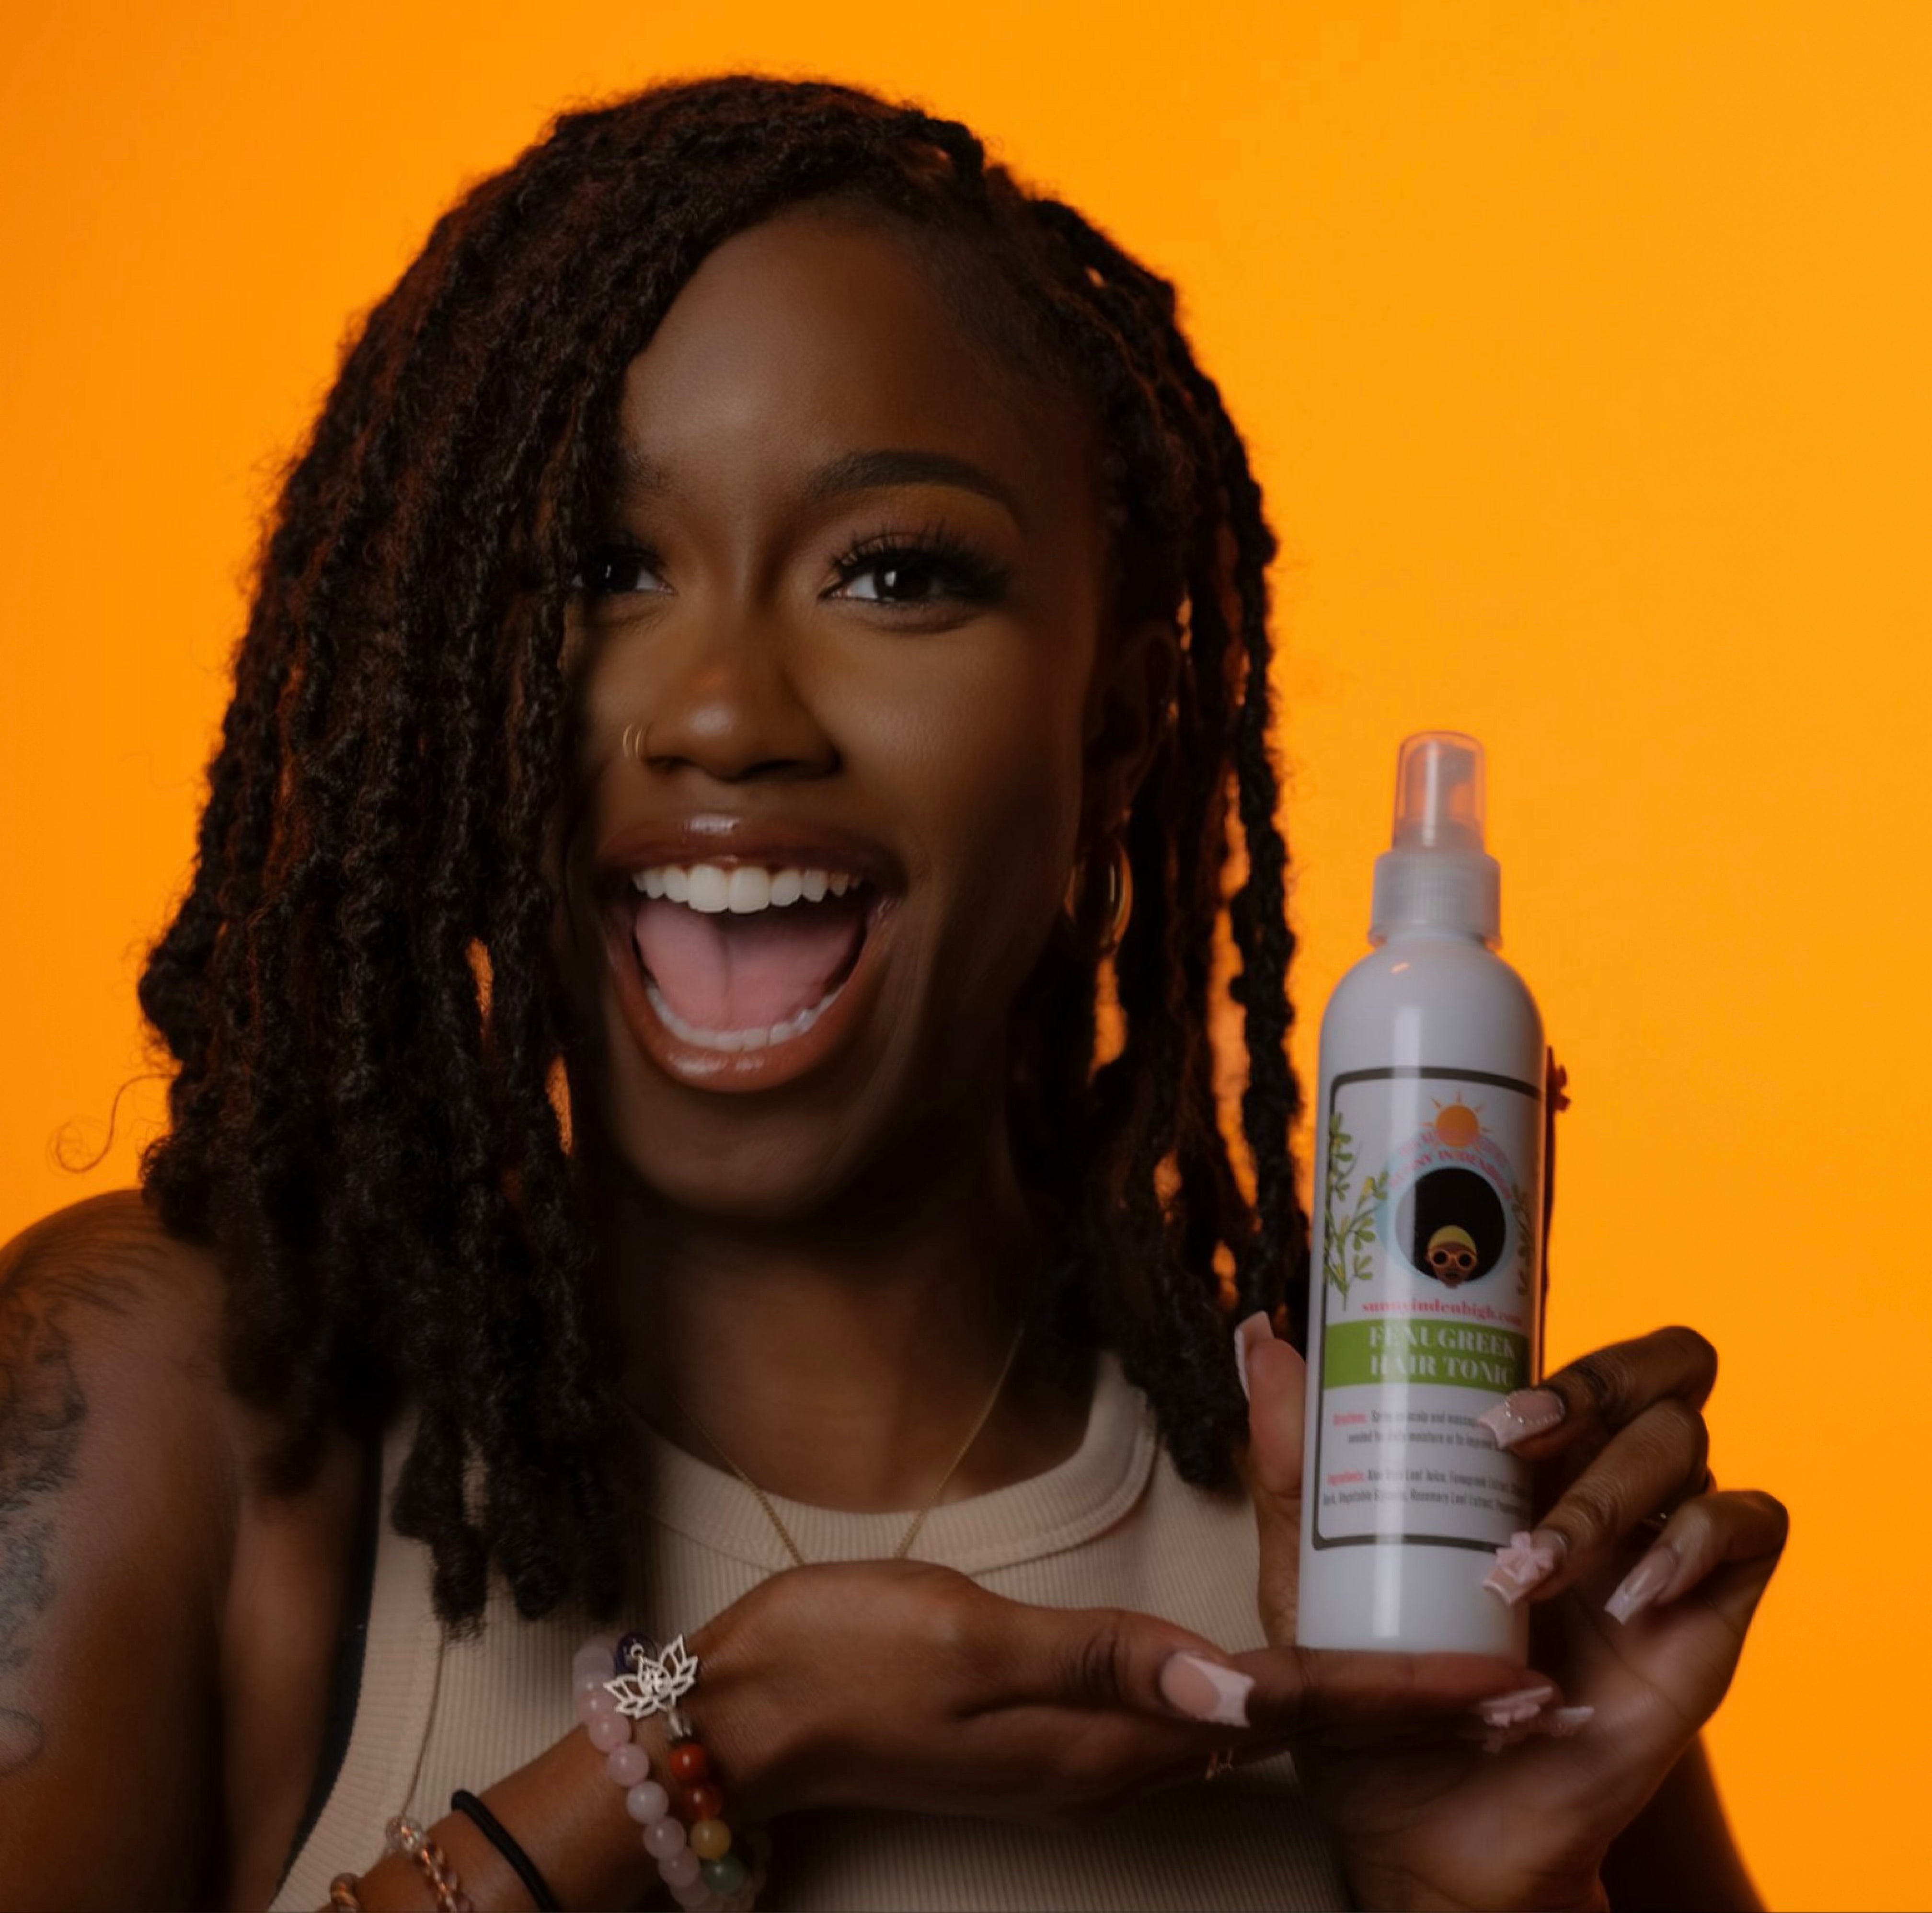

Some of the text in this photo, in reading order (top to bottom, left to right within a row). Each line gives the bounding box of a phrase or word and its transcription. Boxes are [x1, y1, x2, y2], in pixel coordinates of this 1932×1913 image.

[1369, 1325, 1515, 1359] FENUGREEK
[1369, 1354, 1514, 1387] HAIR TONIC
